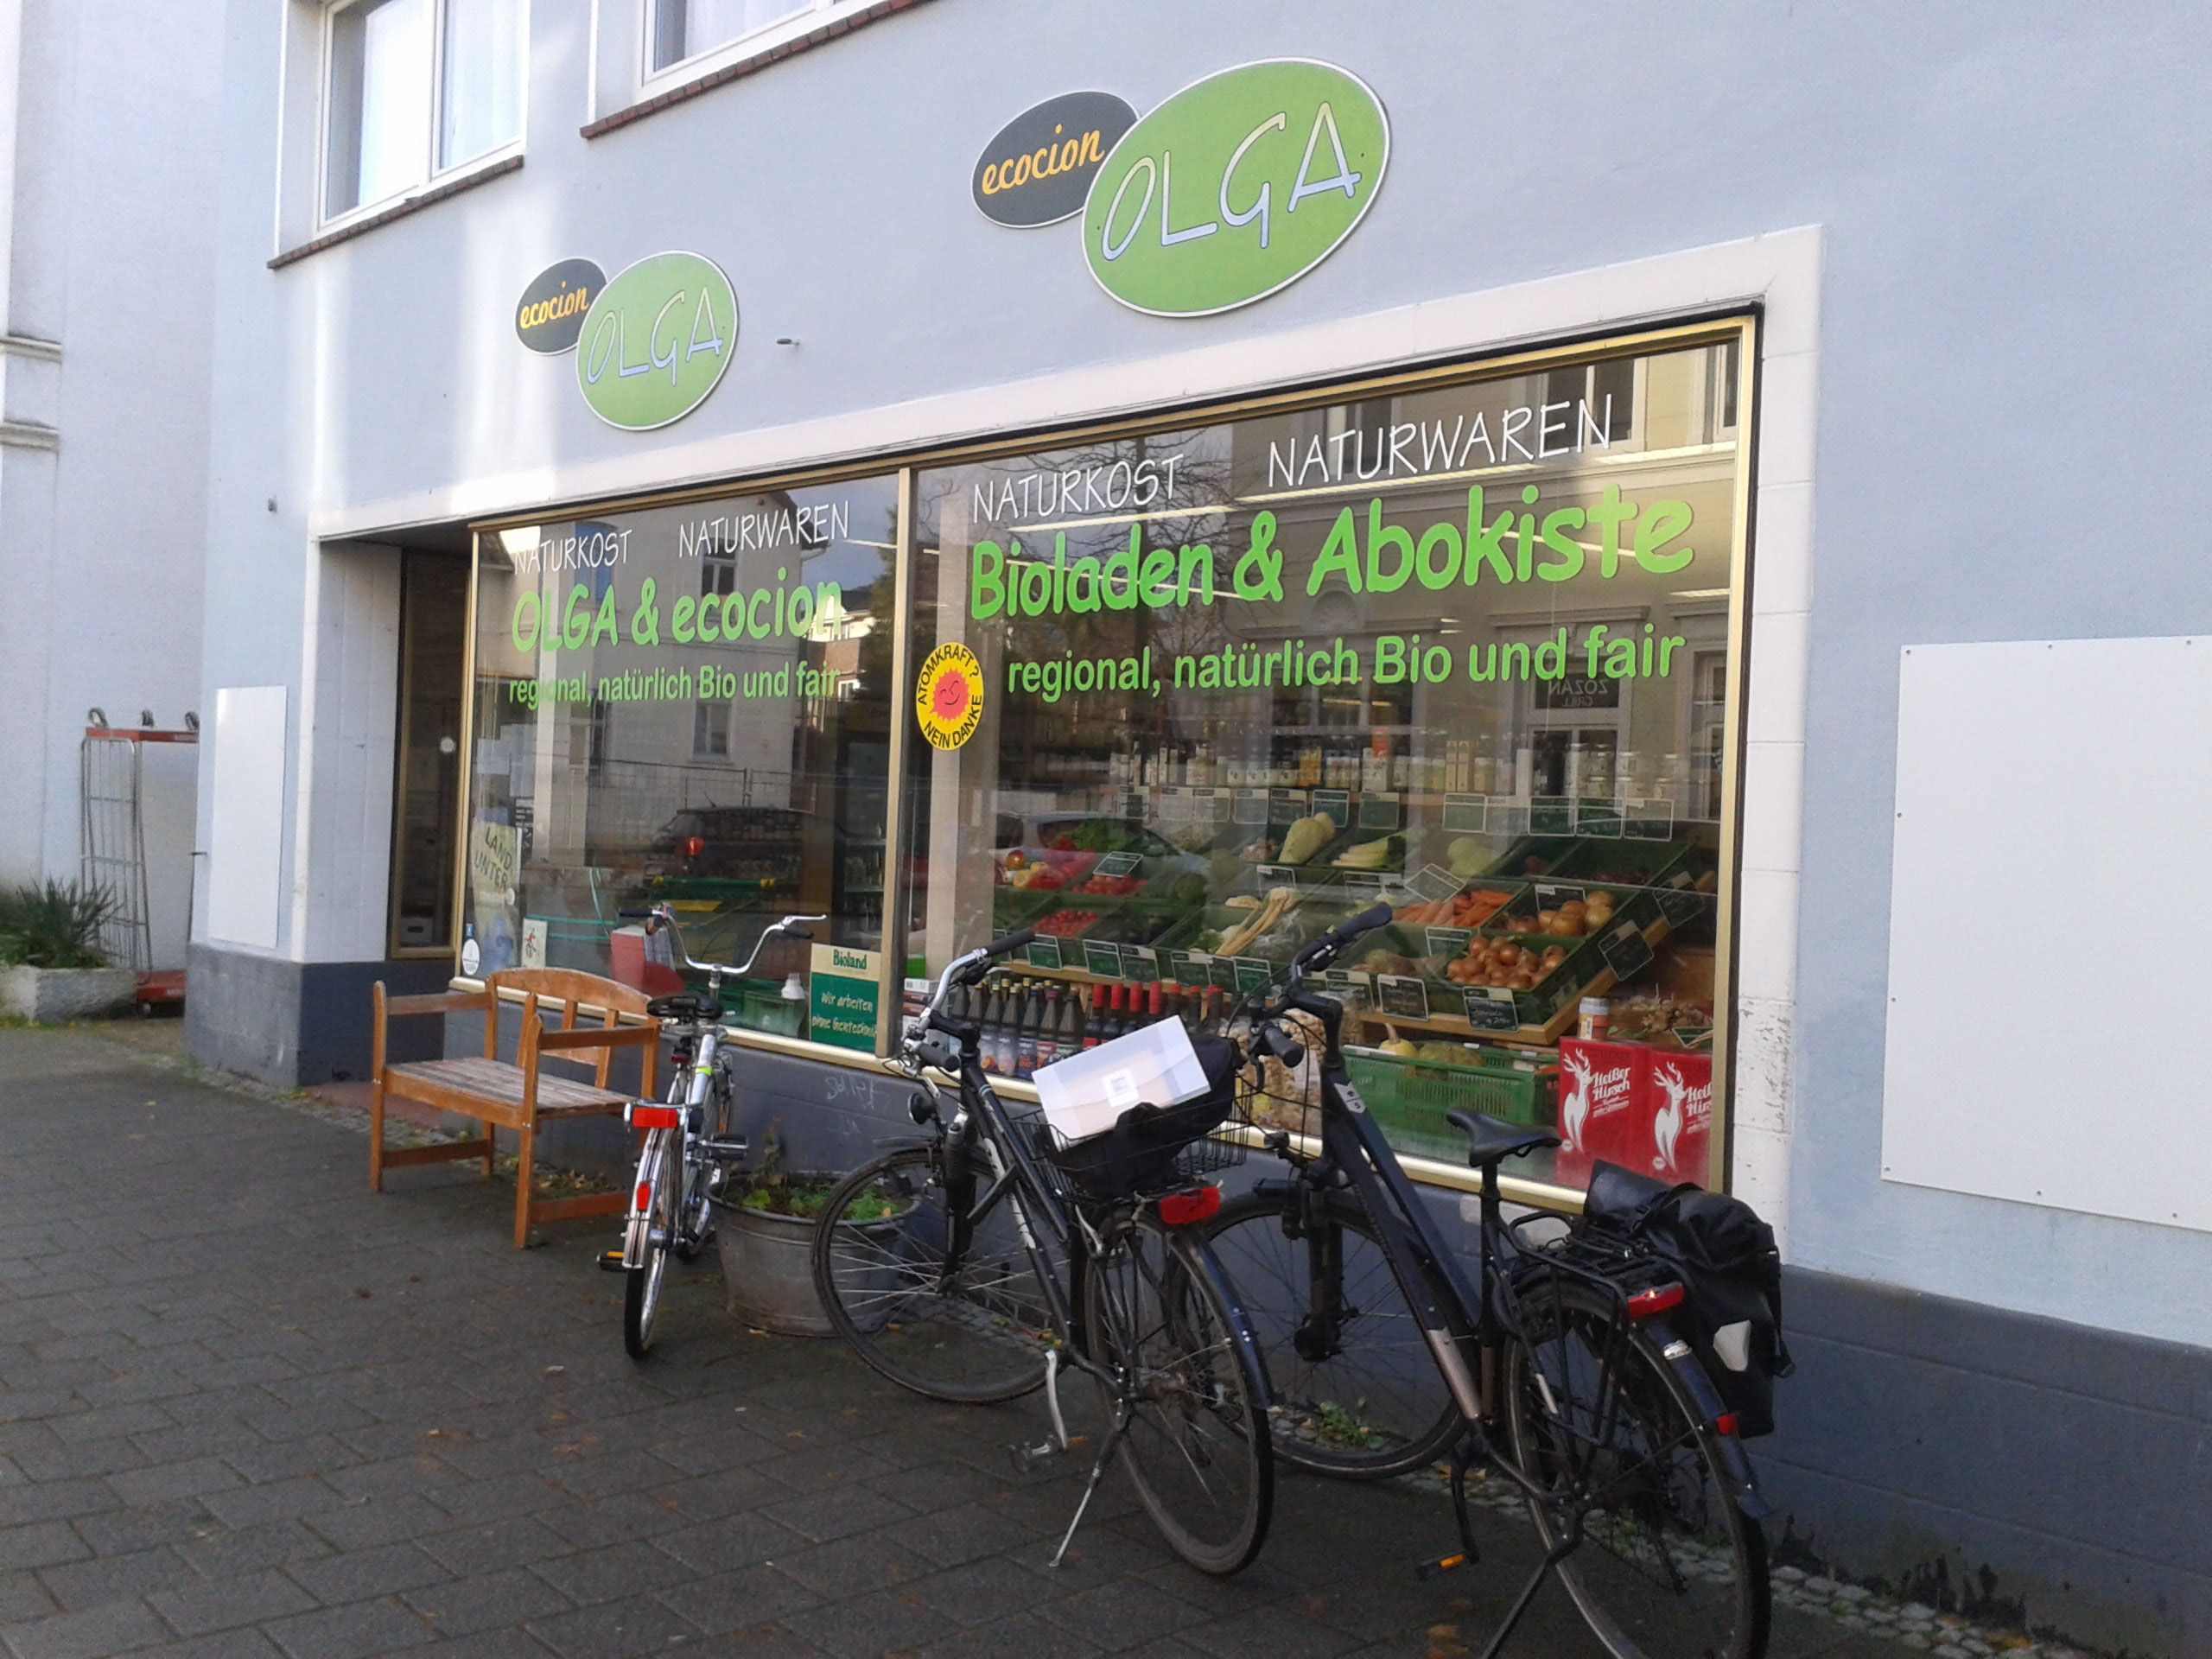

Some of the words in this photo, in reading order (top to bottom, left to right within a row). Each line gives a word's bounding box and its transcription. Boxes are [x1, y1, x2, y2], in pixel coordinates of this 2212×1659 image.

[982, 124, 1104, 194] ecocion
[1102, 101, 1362, 261] OLGA
[520, 281, 590, 329] ecocion
[587, 286, 723, 387] OLGA
[974, 454, 1184, 524] NATURKOST
[1268, 393, 1611, 486] NATURWAREN
[514, 530, 632, 575] NATURKOST
[679, 500, 849, 558] NATURWAREN
[971, 523, 1213, 620] Bioladen
[1234, 511, 1283, 601] &
[1306, 483, 1694, 596] Abokiste
[512, 583, 618, 652] OLGA
[632, 577, 659, 646] &
[671, 567, 842, 643] ecocion
[510, 671, 592, 710] regional,
[598, 666, 691, 701] natürlich
[699, 665, 736, 700] Bio
[744, 662, 789, 697] und
[796, 661, 841, 696] fair
[1008, 646, 1161, 702] regional,
[1175, 638, 1358, 689] natürlich
[1375, 634, 1452, 684] Bio
[1469, 626, 1567, 683] und
[1583, 623, 1685, 680] fair
[924, 720, 950, 748] NEIN
[952, 695, 982, 747] DANKE
[474, 849, 509, 891] UNTER
[485, 825, 512, 871] LAND
[833, 949, 868, 969] Bioland
